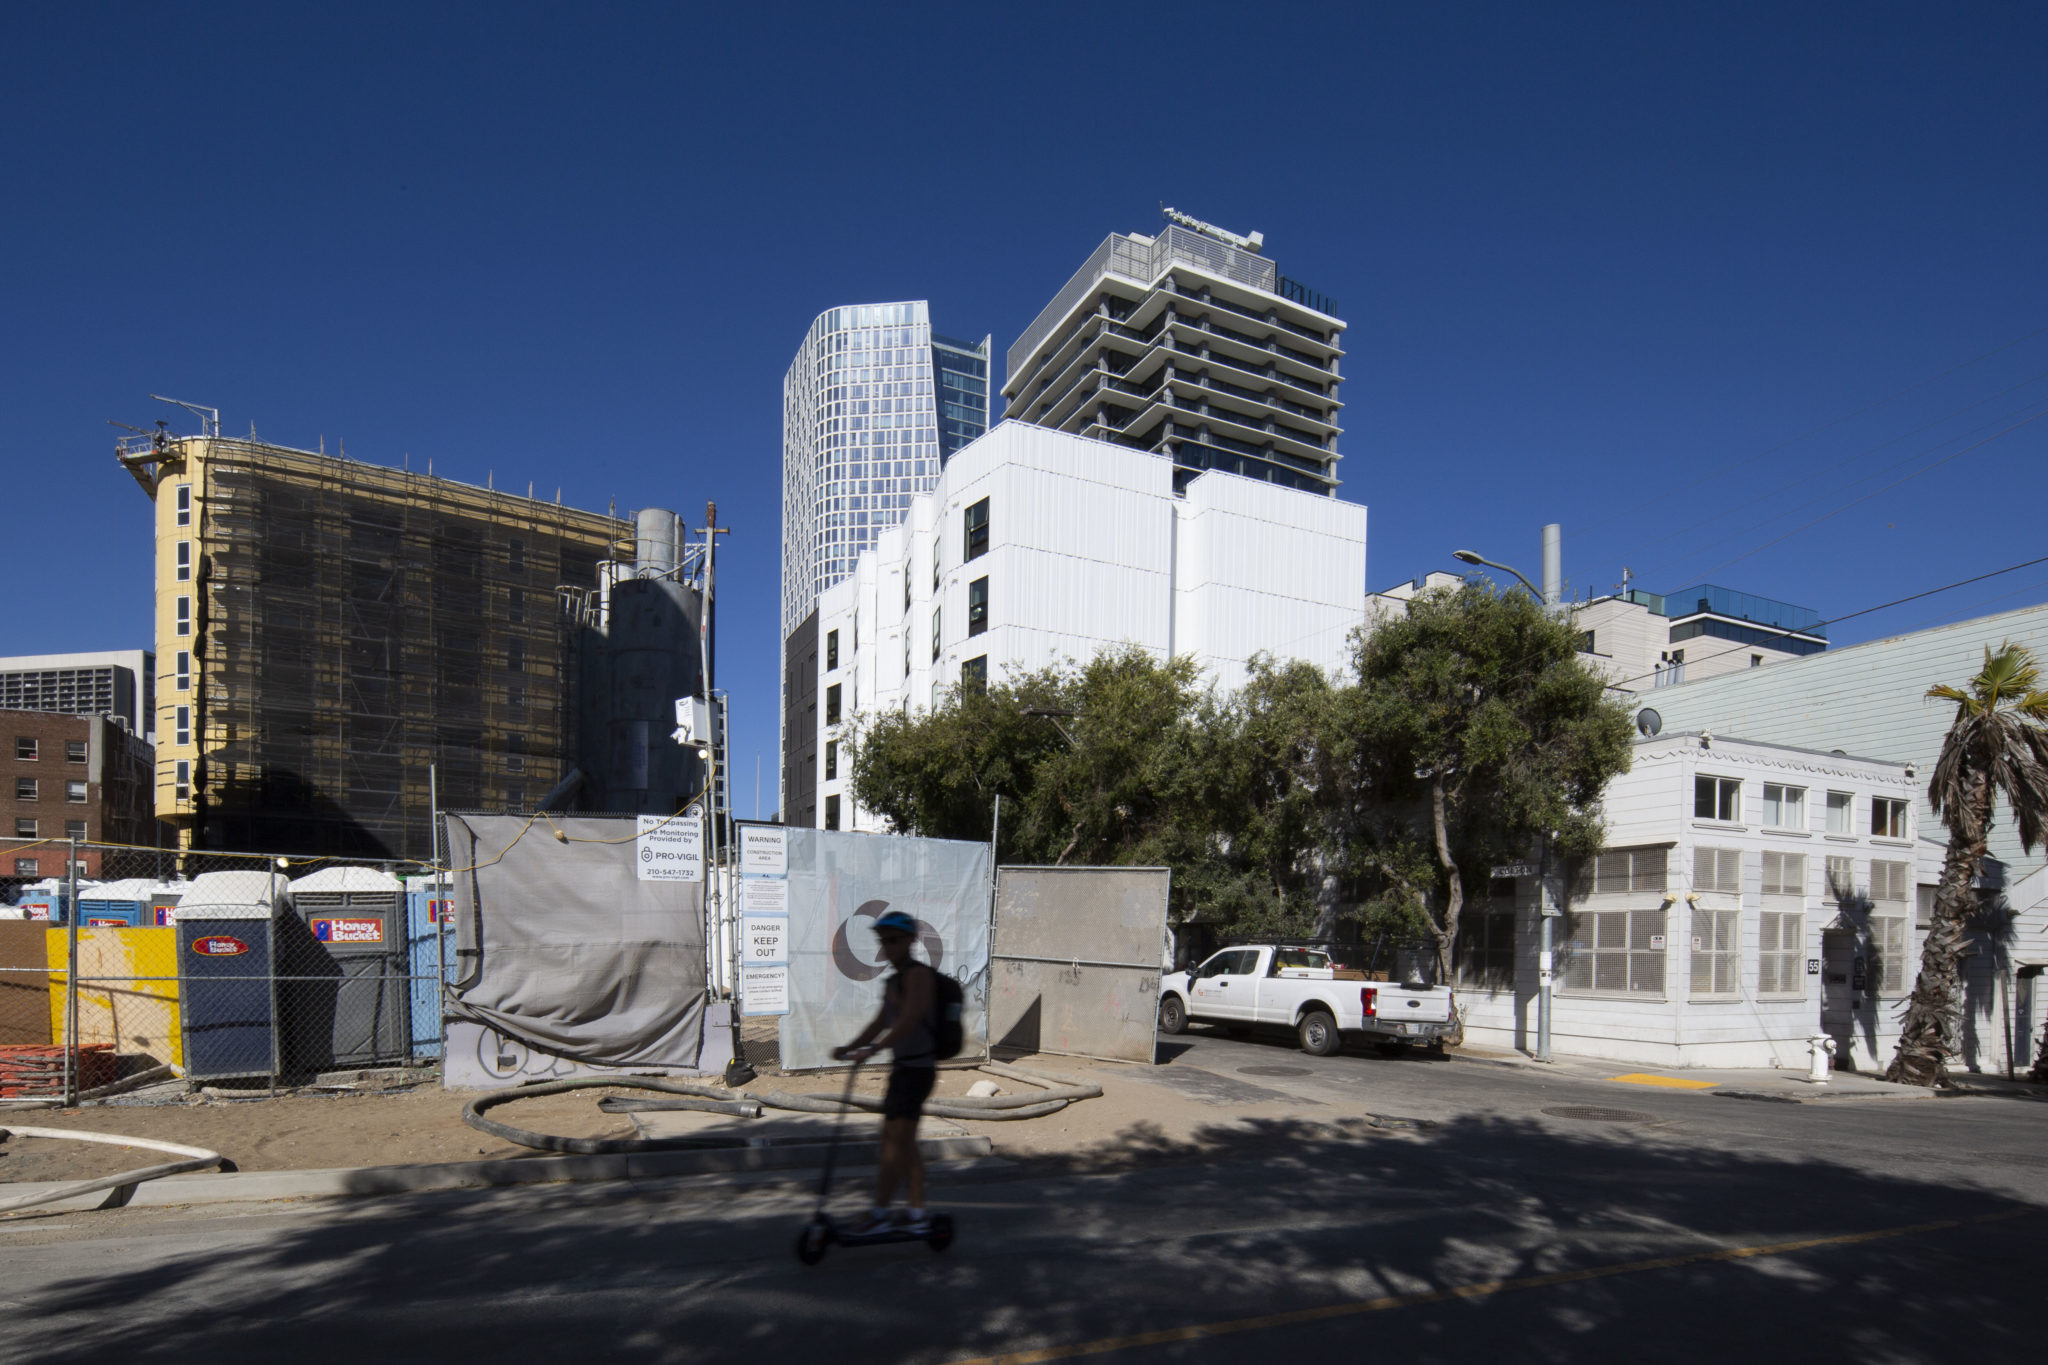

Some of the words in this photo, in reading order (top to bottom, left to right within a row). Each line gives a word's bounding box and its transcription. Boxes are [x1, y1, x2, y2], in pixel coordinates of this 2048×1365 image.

[656, 819, 698, 828] Trspassing
[660, 830, 699, 838] Monitoring
[649, 835, 682, 843] Provided
[683, 836, 693, 844] by
[748, 836, 782, 844] WARNING
[655, 852, 700, 861] PRO-VIGIL
[647, 868, 694, 877] 210-547-1732
[331, 920, 376, 932] Honey
[751, 924, 781, 932] DANGER
[332, 930, 381, 941] Bucket
[753, 937, 779, 945] KEEP
[756, 948, 776, 957] OUT
[1808, 961, 1819, 972] 55
